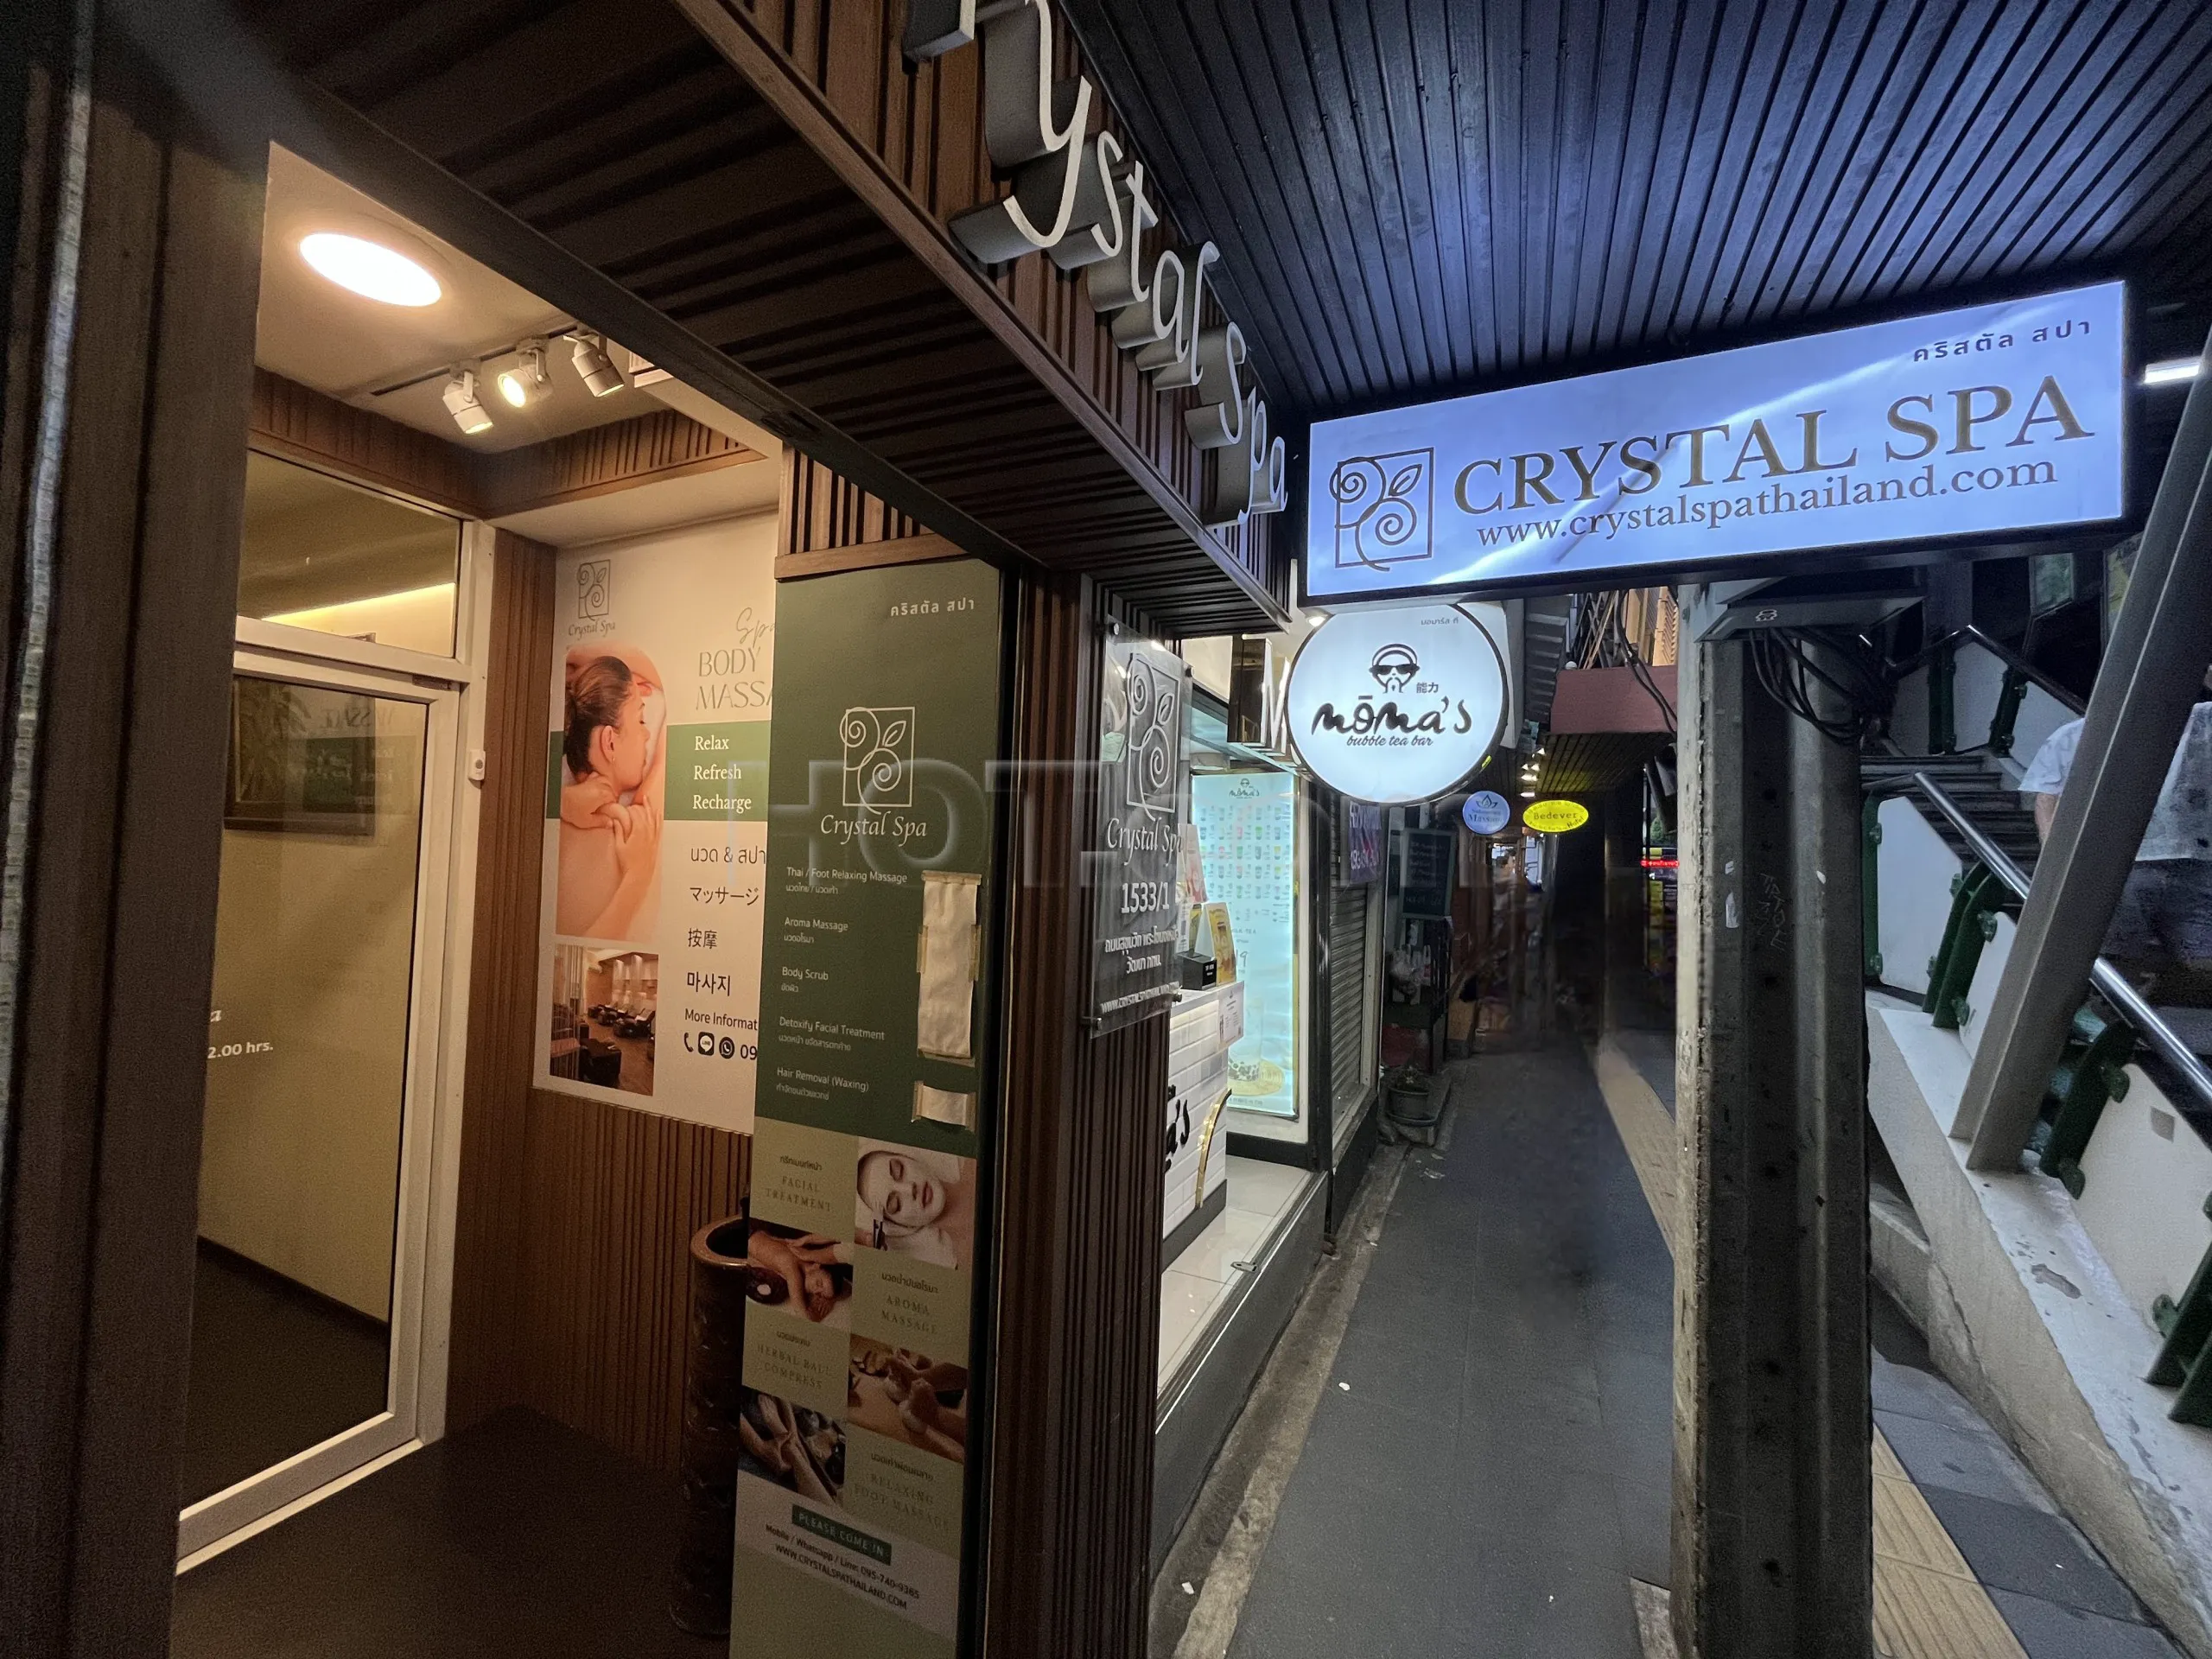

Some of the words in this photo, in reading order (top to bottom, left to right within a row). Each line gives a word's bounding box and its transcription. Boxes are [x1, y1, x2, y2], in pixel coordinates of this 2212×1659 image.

[1913, 330, 2015, 363] คริสตัล
[2031, 318, 2092, 346] สปา
[1218, 321, 1287, 524] Spa
[1452, 409, 1859, 516] CRYSTAL
[1884, 374, 2095, 463] SPA
[1476, 456, 2058, 548] www.crystalspathailand.com
[890, 600, 939, 617] คริสตัล
[947, 597, 975, 612] สปา
[569, 620, 598, 640] Crystal
[601, 620, 616, 638] Spa
[698, 647, 760, 677] BODY
[694, 734, 730, 751] Relax
[1346, 735, 1386, 747] bubble
[1389, 735, 1409, 747] tea
[1411, 735, 1433, 747] bar
[693, 764, 742, 780] Refresh
[692, 793, 752, 814] Recharge
[1534, 811, 1578, 820] Bedever
[821, 810, 891, 845] Crystal
[892, 816, 927, 847] Spa
[1106, 817, 1161, 865] Crystal
[1162, 824, 1182, 867] Spa
[690, 848, 719, 862] นวด
[723, 846, 734, 863] &
[738, 845, 766, 864] สปา
[786, 867, 804, 877] Thai
[811, 868, 830, 879] Foot
[831, 869, 868, 883] Relaxing
[869, 871, 908, 884] Massage
[690, 887, 760, 906] マッサージ
[1121, 881, 1170, 913] 1533/1
[784, 916, 810, 928] Aroma
[812, 918, 849, 932] Massage
[688, 927, 718, 949] 按摩
[687, 971, 731, 997] 마사지
[782, 966, 803, 980] Body
[804, 969, 830, 981] Scrub
[684, 1007, 711, 1024] More
[713, 1012, 758, 1032] Informat
[779, 1015, 813, 1033] Detoxify
[815, 1020, 839, 1034] Facial
[841, 1024, 885, 1041] Treatment
[245, 1041, 274, 1054] hrs.
[776, 1066, 793, 1077] Hair
[795, 1069, 830, 1084] Removal
[831, 1075, 869, 1093] (Waxing)
[782, 1176, 820, 1192] FACIAL
[765, 1187, 830, 1212] TREATMENT
[886, 1295, 930, 1316] AROMA
[881, 1309, 938, 1334] MASSAGE
[764, 1362, 823, 1389] COMPRESS
[798, 1513, 836, 1537] PLEASE
[840, 1530, 868, 1551] COME
[871, 1542, 884, 1556] IN
